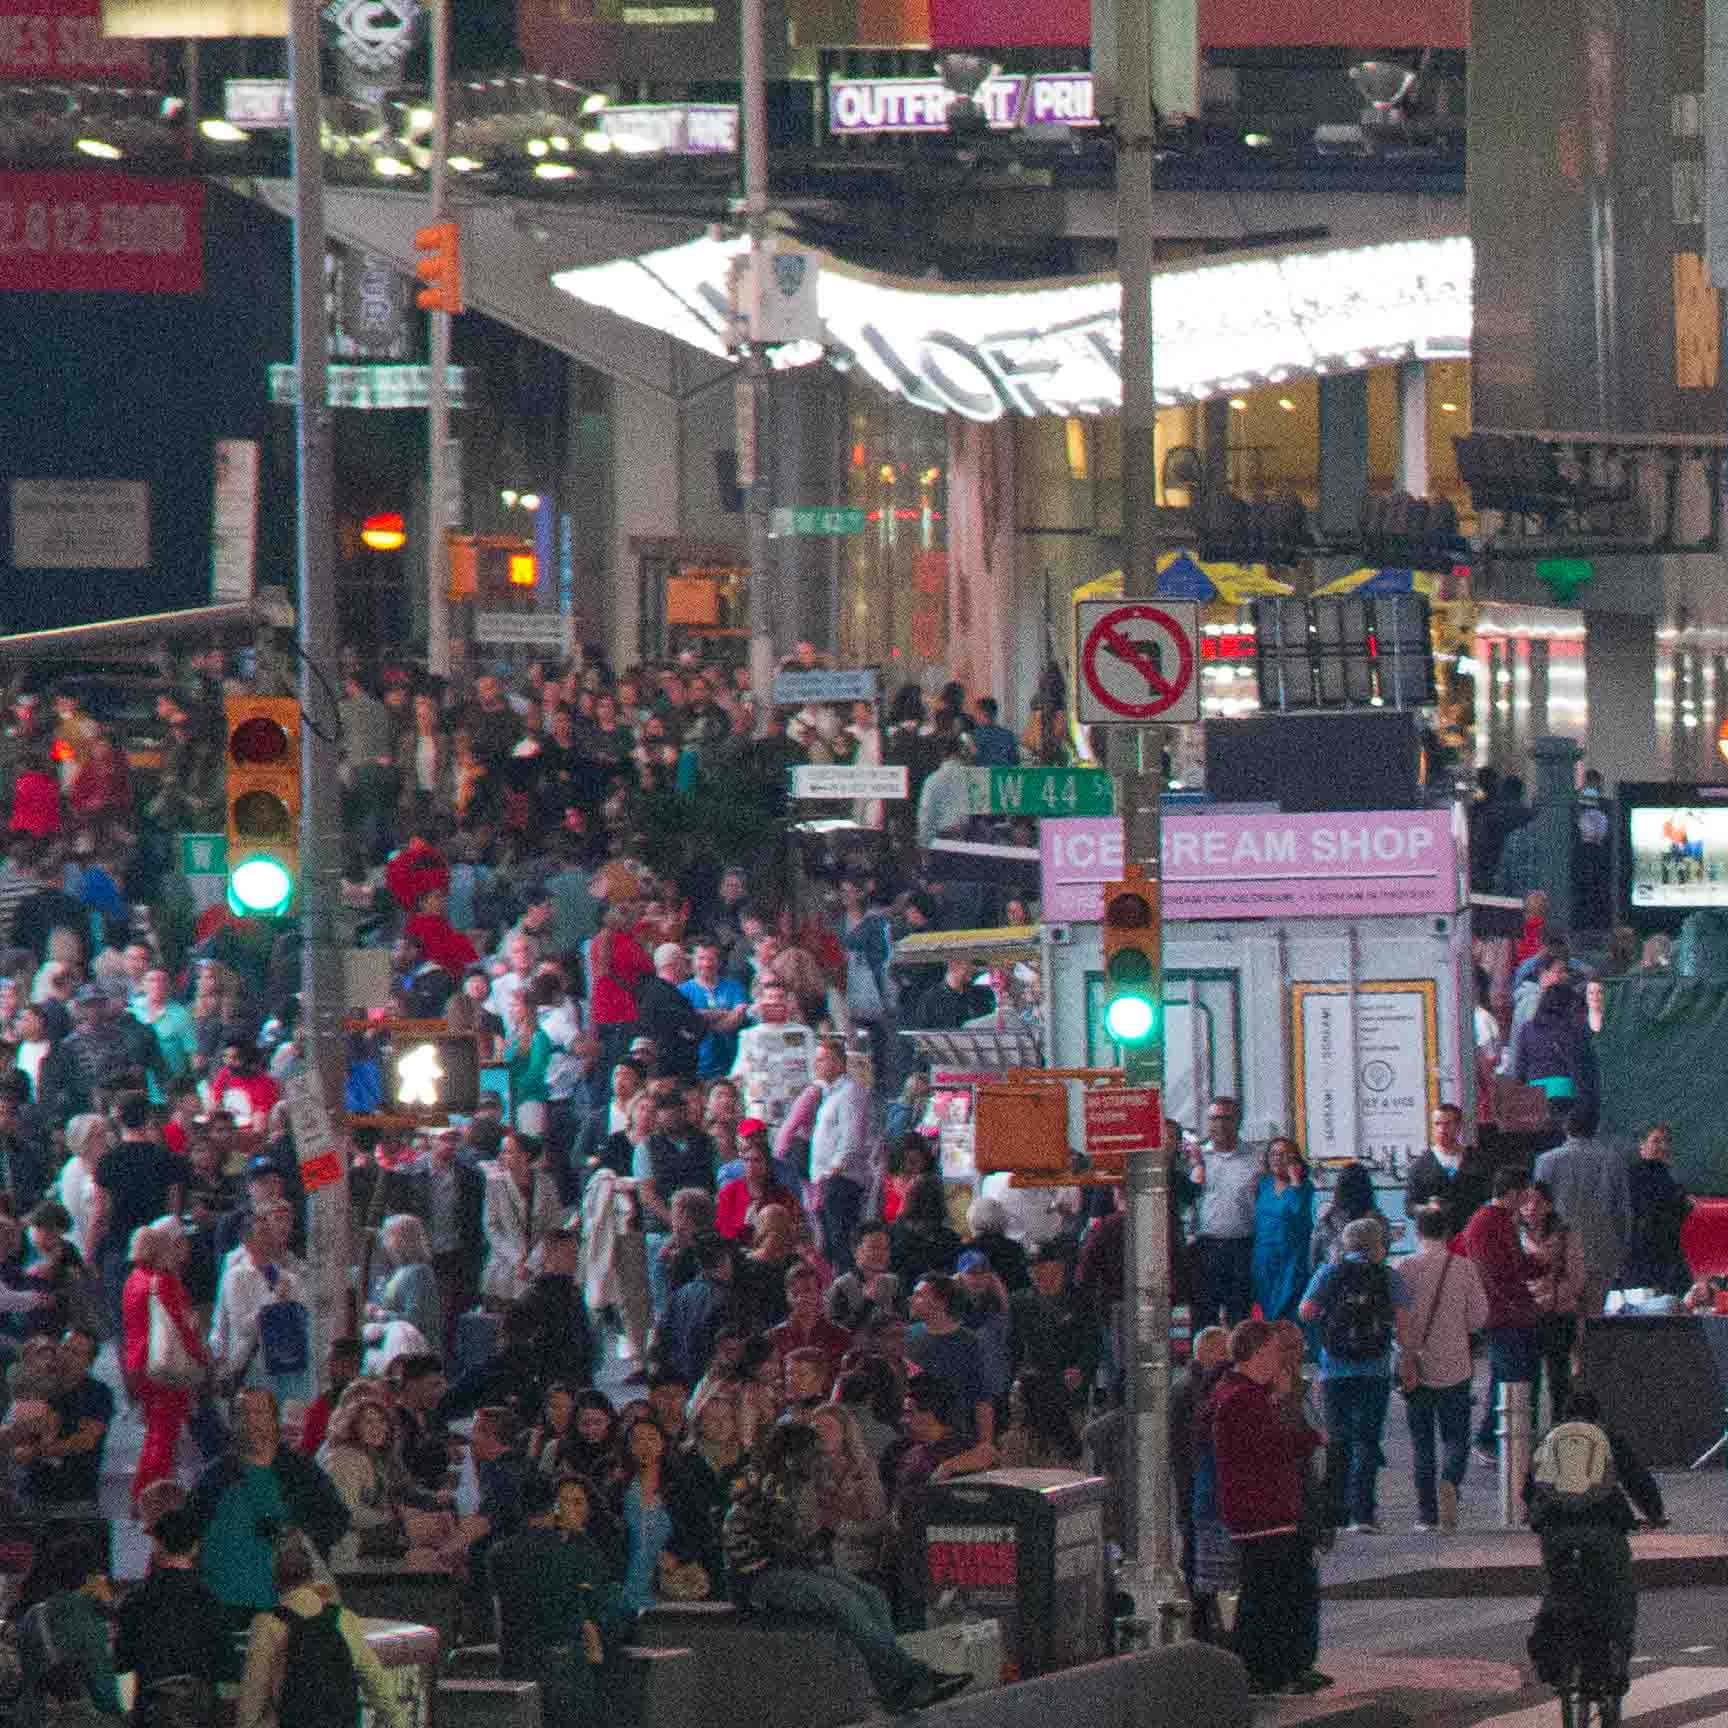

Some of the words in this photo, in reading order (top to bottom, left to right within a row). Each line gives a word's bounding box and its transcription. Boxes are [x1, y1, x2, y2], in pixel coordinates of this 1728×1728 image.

[999, 775, 1024, 809] W
[1040, 775, 1078, 808] 44
[1054, 834, 1123, 868] ICE
[1160, 831, 1297, 865] REAM
[1311, 826, 1434, 863] SHOP
